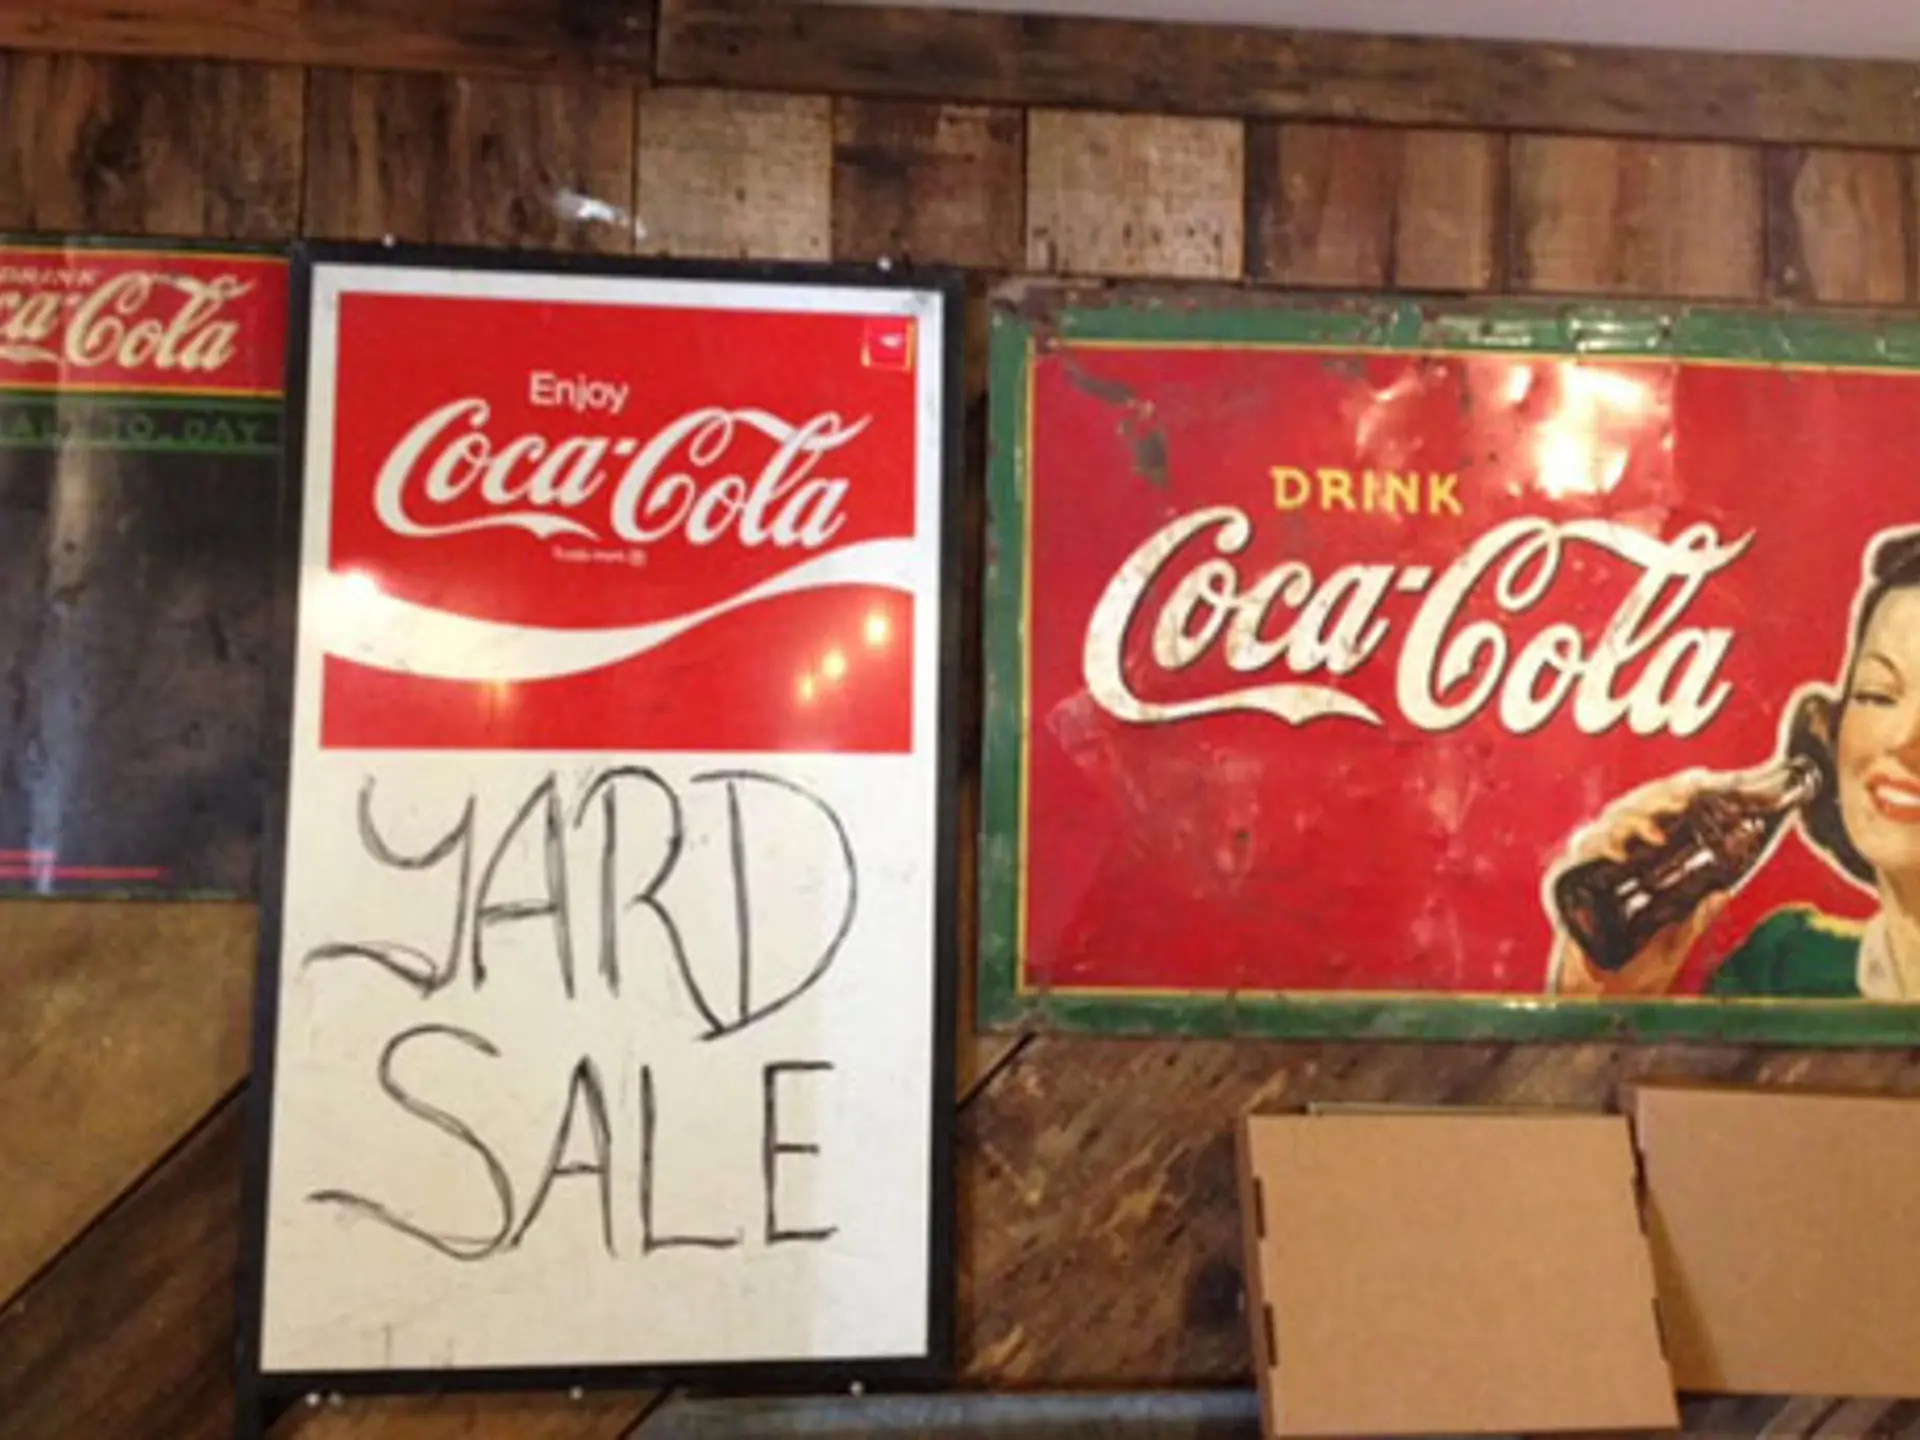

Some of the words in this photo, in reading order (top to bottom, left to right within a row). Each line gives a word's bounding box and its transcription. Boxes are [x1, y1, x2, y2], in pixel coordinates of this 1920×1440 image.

[374, 398, 872, 547] Coca-Cola
[529, 371, 628, 414] Enjoy
[1270, 466, 1463, 516] DRINK
[1082, 506, 1755, 737] Coca-Cola
[301, 766, 858, 1042] YARD
[306, 1024, 838, 1261] SALE
